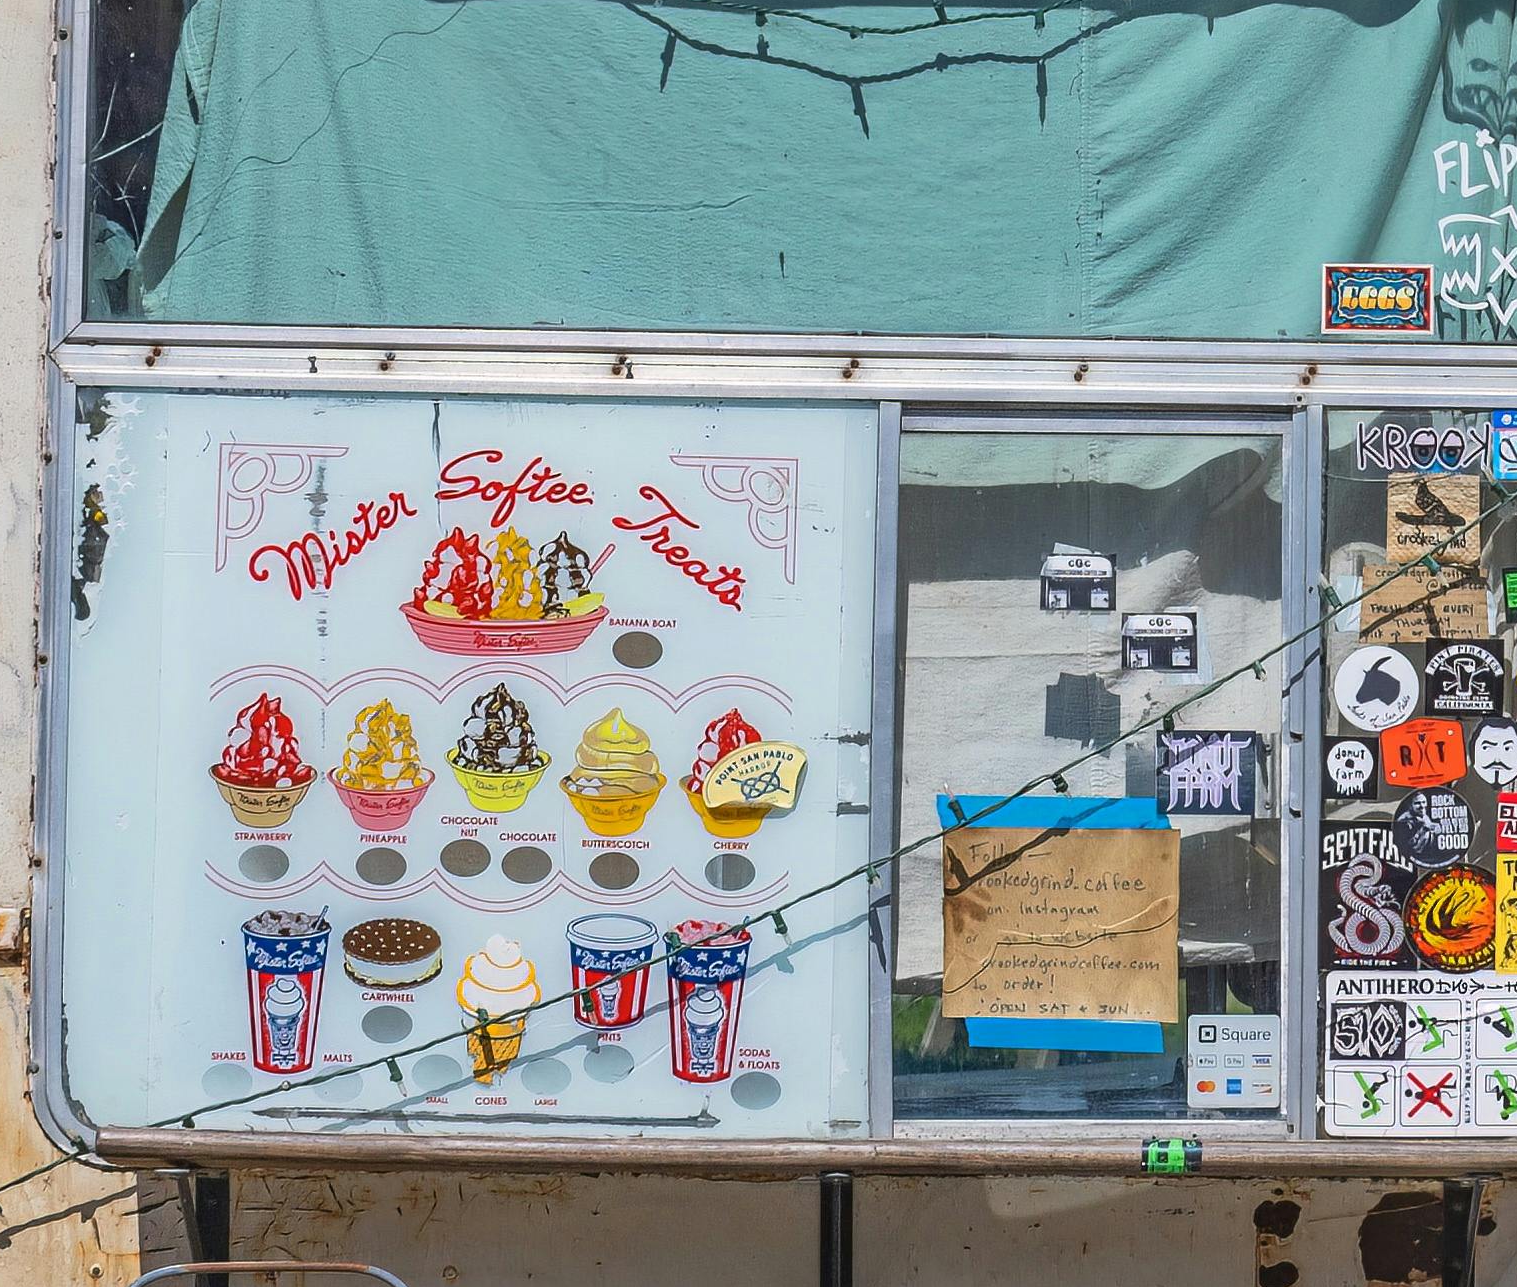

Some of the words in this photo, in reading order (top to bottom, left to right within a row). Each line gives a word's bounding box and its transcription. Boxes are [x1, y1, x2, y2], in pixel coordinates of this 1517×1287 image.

[1341, 285, 1415, 311] EGGS
[249, 489, 418, 602] Mister
[434, 449, 593, 525] Softee
[612, 484, 743, 612] Treats
[608, 618, 650, 629] BANANA
[652, 619, 677, 630] BOAT
[1335, 747, 1365, 760] donut
[715, 761, 740, 785] POINT
[740, 752, 760, 765] SAN
[763, 750, 794, 761] PABLO
[1336, 768, 1365, 780] farm
[1431, 794, 1456, 807] ROCK
[1431, 805, 1468, 819] BOTTOM
[440, 815, 499, 826] CHOCOLATE
[234, 831, 293, 842] STRAWBERRY
[460, 827, 479, 838] NUT
[499, 831, 558, 844] CHOCOLATE
[359, 833, 408, 845] PINEAPPLE
[581, 839, 651, 850] BUTTERSCOTCH
[1437, 833, 1469, 851] GOOD
[713, 840, 750, 852] CHERRY
[253, 947, 287, 970] Mister
[580, 949, 611, 971] Mister
[675, 957, 708, 978] Mister
[1335, 977, 1434, 996] ANTIHERO
[361, 992, 415, 1003] CARTWHEEL
[989, 1002, 1026, 1013] OPEN
[1039, 1002, 1069, 1014] SAT
[597, 1032, 622, 1043] PINTS
[1221, 1027, 1272, 1044] Square
[211, 1051, 247, 1061] SHAKES
[323, 1053, 353, 1063] MALTS
[739, 1048, 771, 1058] SODAS
[738, 1061, 746, 1070] &
[746, 1060, 781, 1071] FLOATS
[425, 1096, 449, 1105] SMALL
[474, 1095, 508, 1106] CONES
